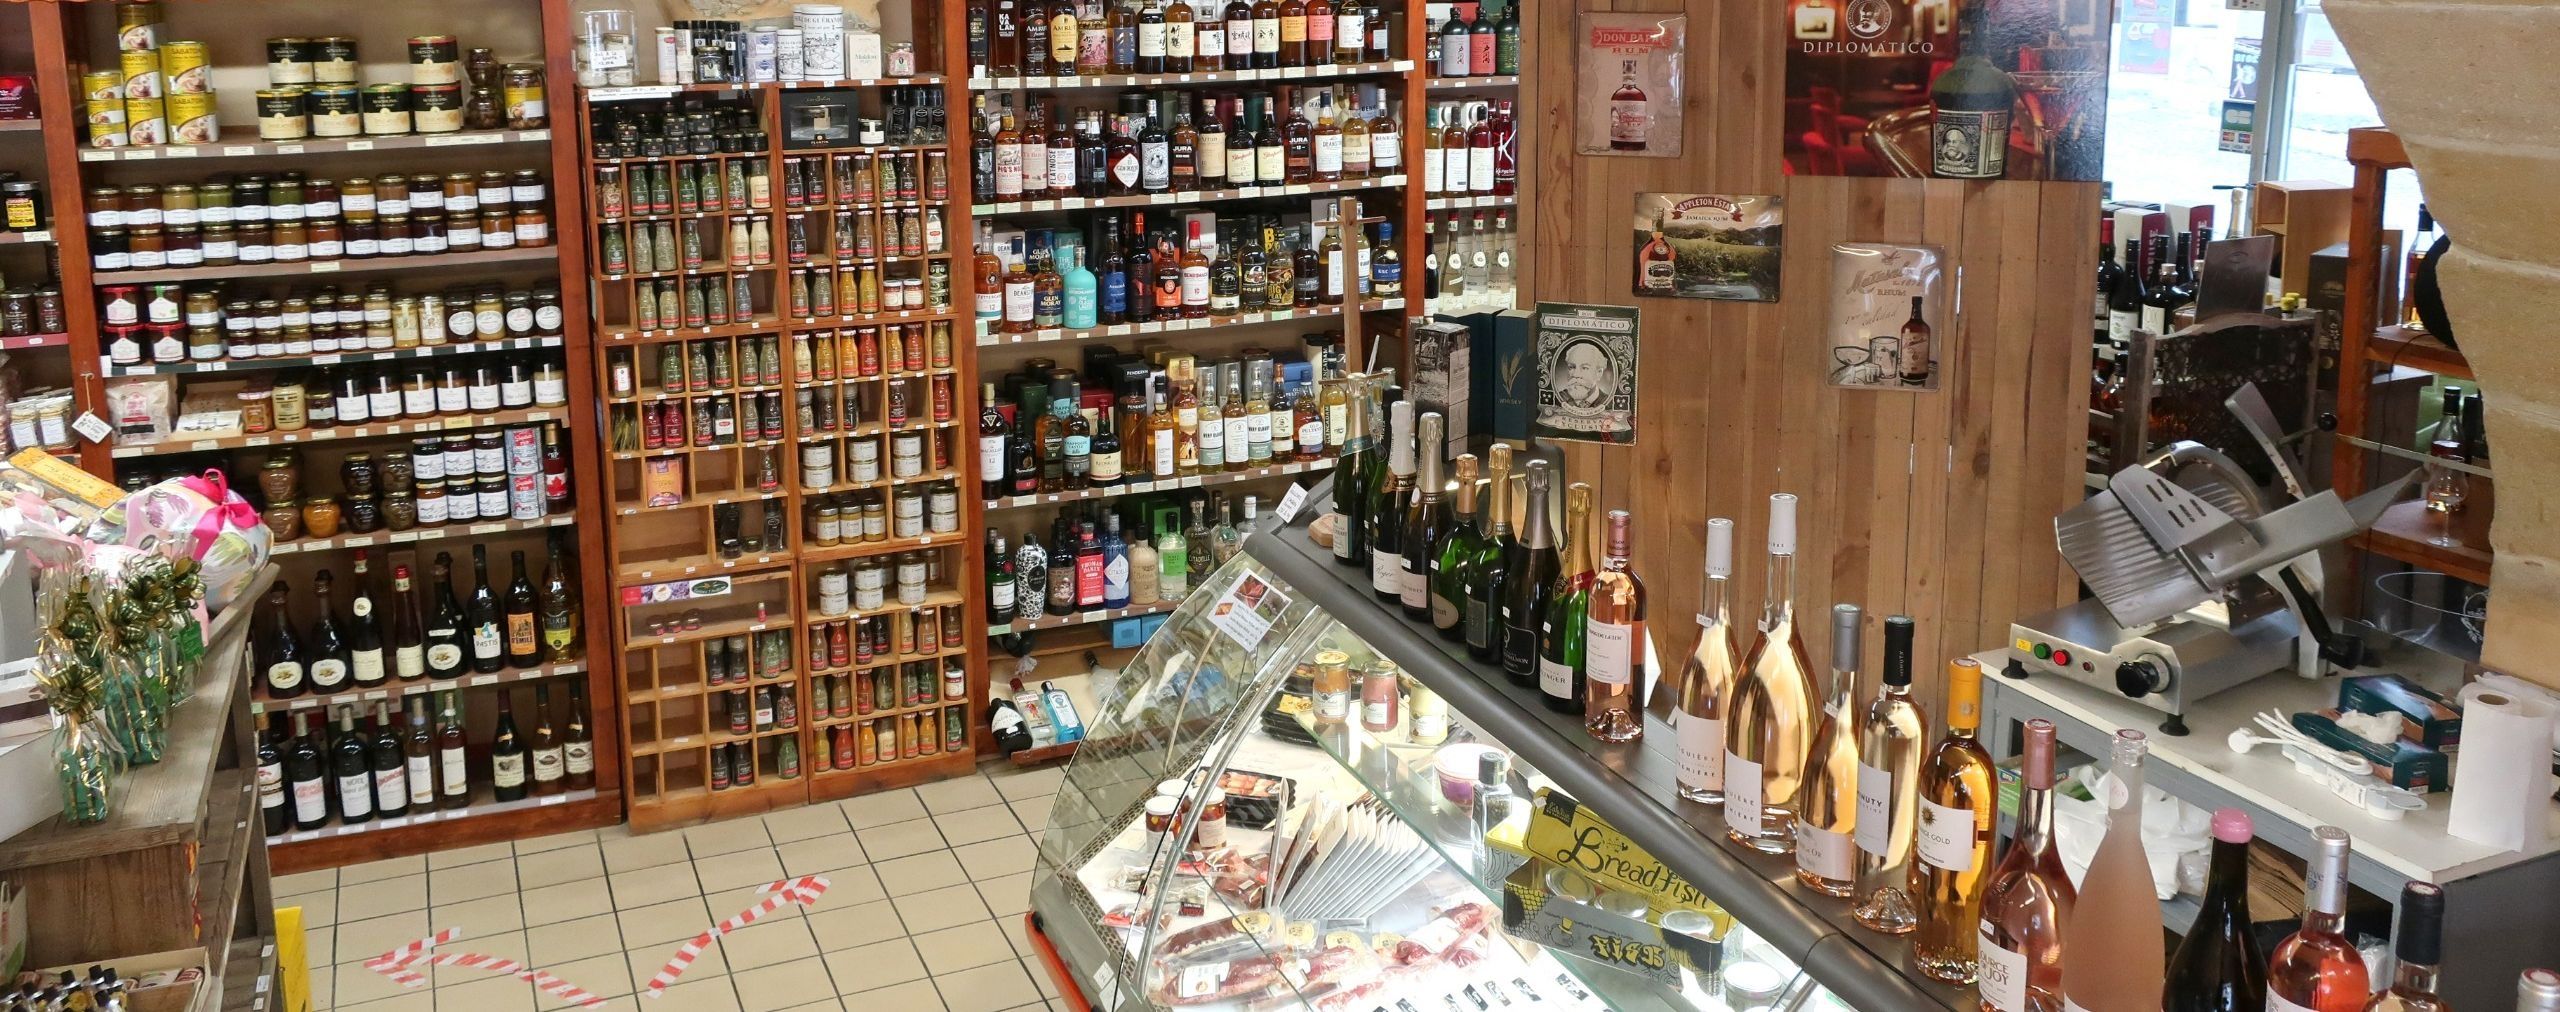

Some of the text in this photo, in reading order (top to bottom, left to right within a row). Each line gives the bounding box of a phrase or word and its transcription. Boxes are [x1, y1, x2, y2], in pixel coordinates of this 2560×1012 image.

[1603, 32, 1626, 42] DON
[1803, 40, 1934, 54] DIPLOMÁTICO
[1549, 318, 1625, 330] DIPLOMÁTICO
[1555, 419, 1603, 430] EXCLUSI
[1081, 561, 1103, 569] THOMAS
[476, 640, 498, 648] PASTIS
[1931, 833, 1951, 846] GOLD
[1556, 826, 1660, 889] Bread
[1985, 967, 2009, 986] JOY
